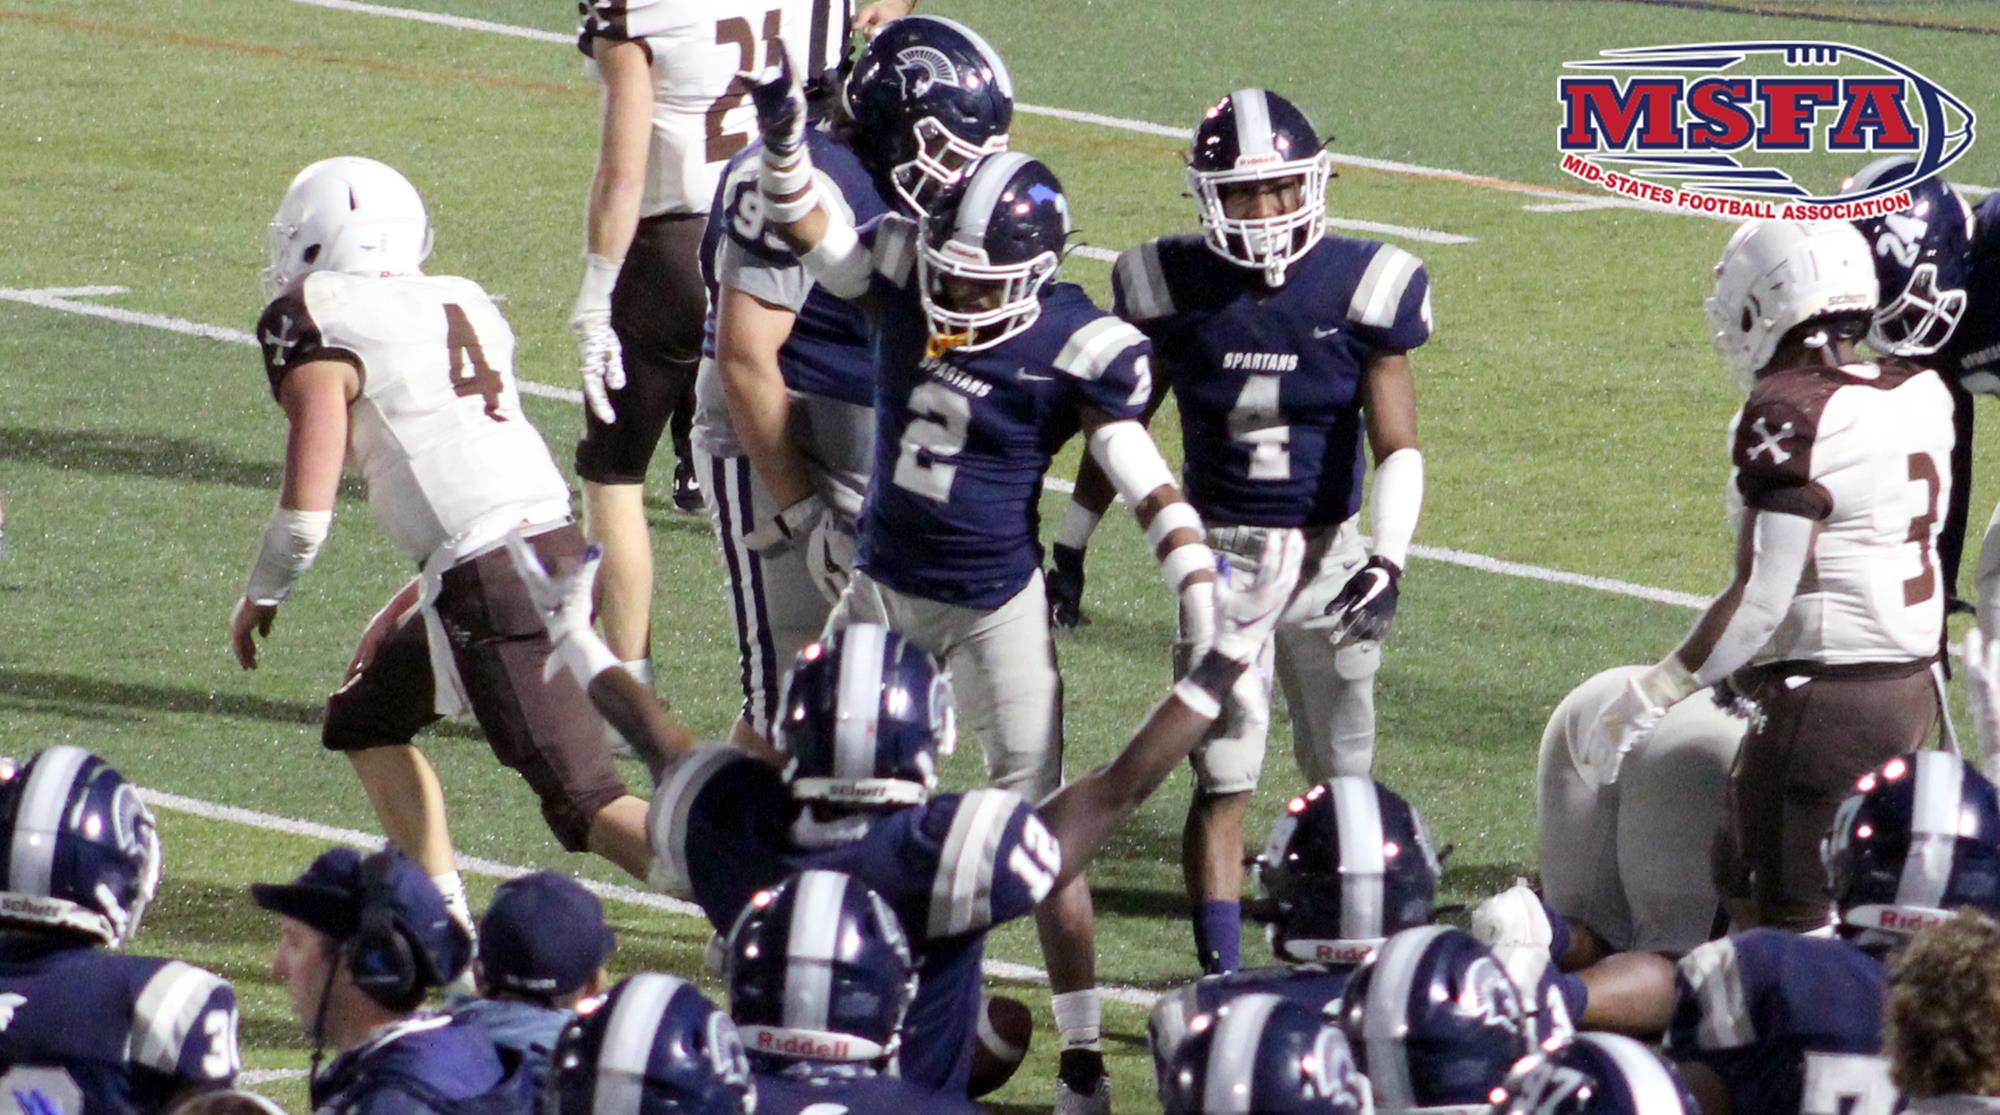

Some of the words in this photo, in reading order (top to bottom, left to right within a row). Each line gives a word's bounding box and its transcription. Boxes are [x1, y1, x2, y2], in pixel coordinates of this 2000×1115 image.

[443, 303, 511, 422] 4
[1222, 352, 1299, 372] SPARTANS
[893, 381, 971, 503] 2
[1227, 374, 1291, 480] 4
[1901, 451, 1940, 607] 3
[1009, 814, 1062, 903] 12
[757, 1030, 849, 1057] Riddell
